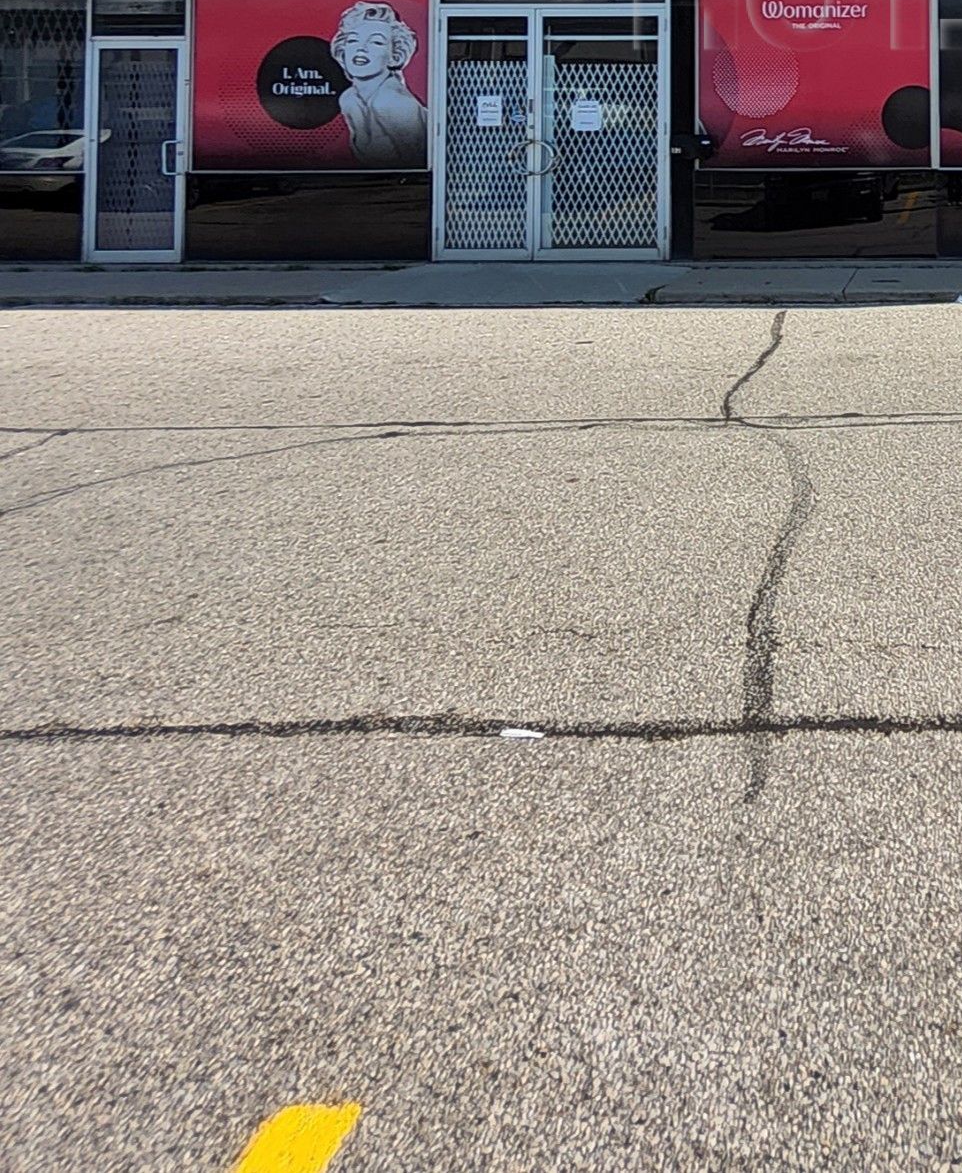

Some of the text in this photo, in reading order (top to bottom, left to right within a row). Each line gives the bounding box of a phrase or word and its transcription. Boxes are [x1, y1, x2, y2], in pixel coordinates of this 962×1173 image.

[762, 0, 868, 19] Womanizer
[294, 67, 323, 79] Am.
[272, 82, 336, 98] Original.
